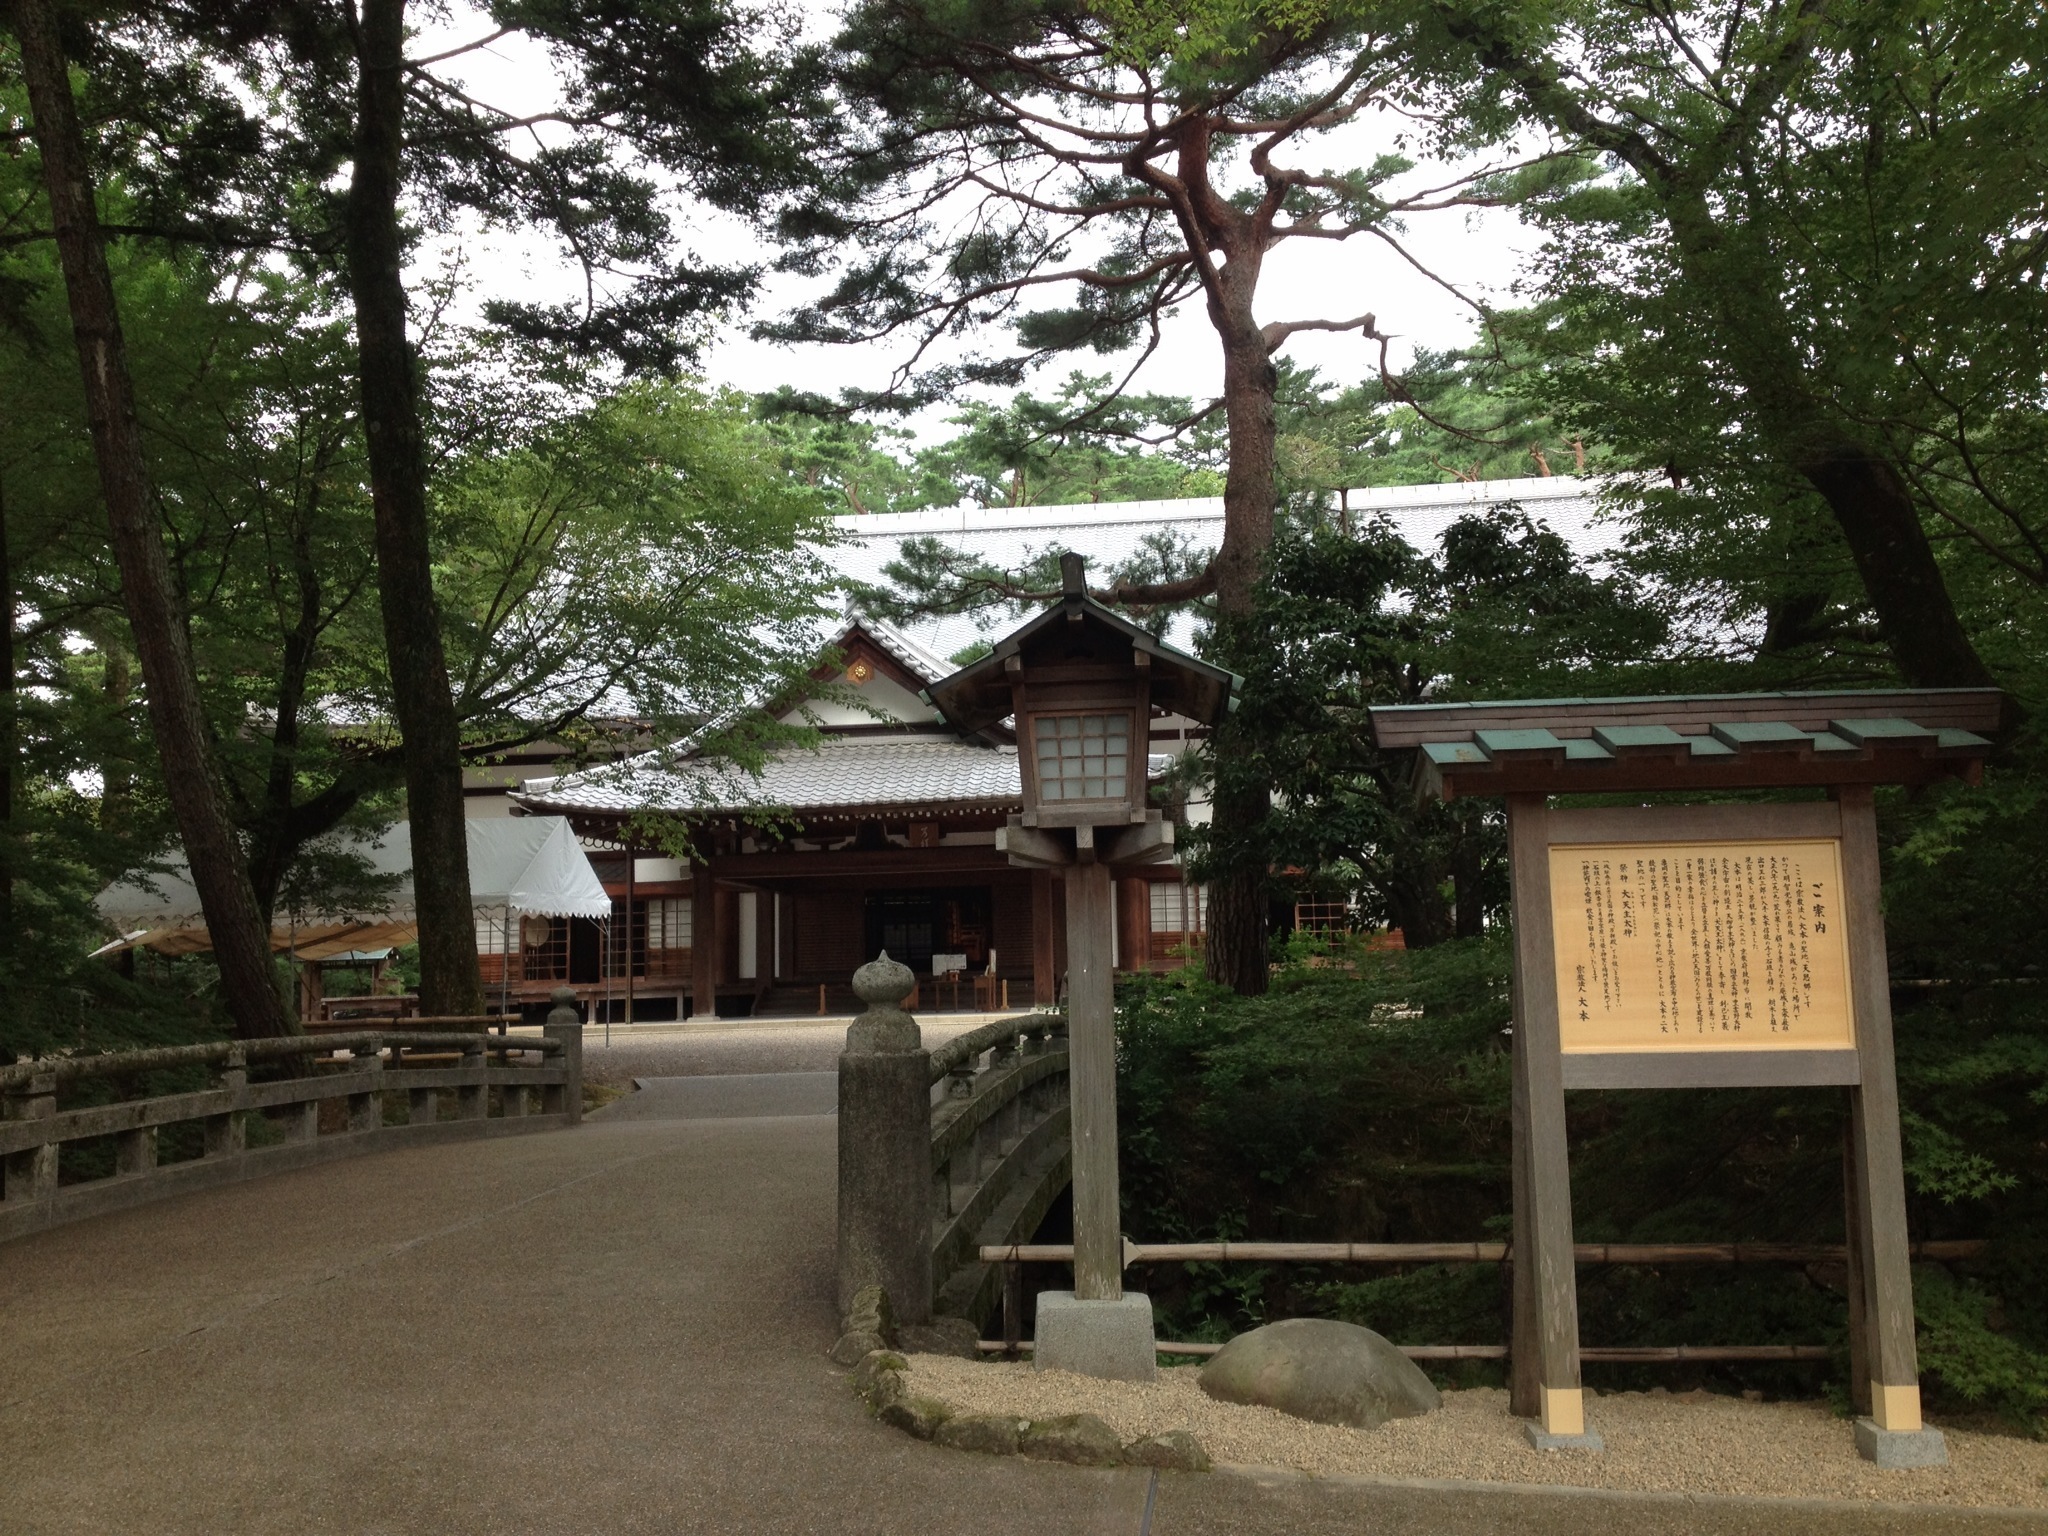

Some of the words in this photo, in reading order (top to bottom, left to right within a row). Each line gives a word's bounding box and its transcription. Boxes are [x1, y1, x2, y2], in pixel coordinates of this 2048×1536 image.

[1811, 881, 1826, 934] ご案内
[1575, 963, 1587, 993] 宗教法人
[1577, 995, 1591, 1022] 大本
